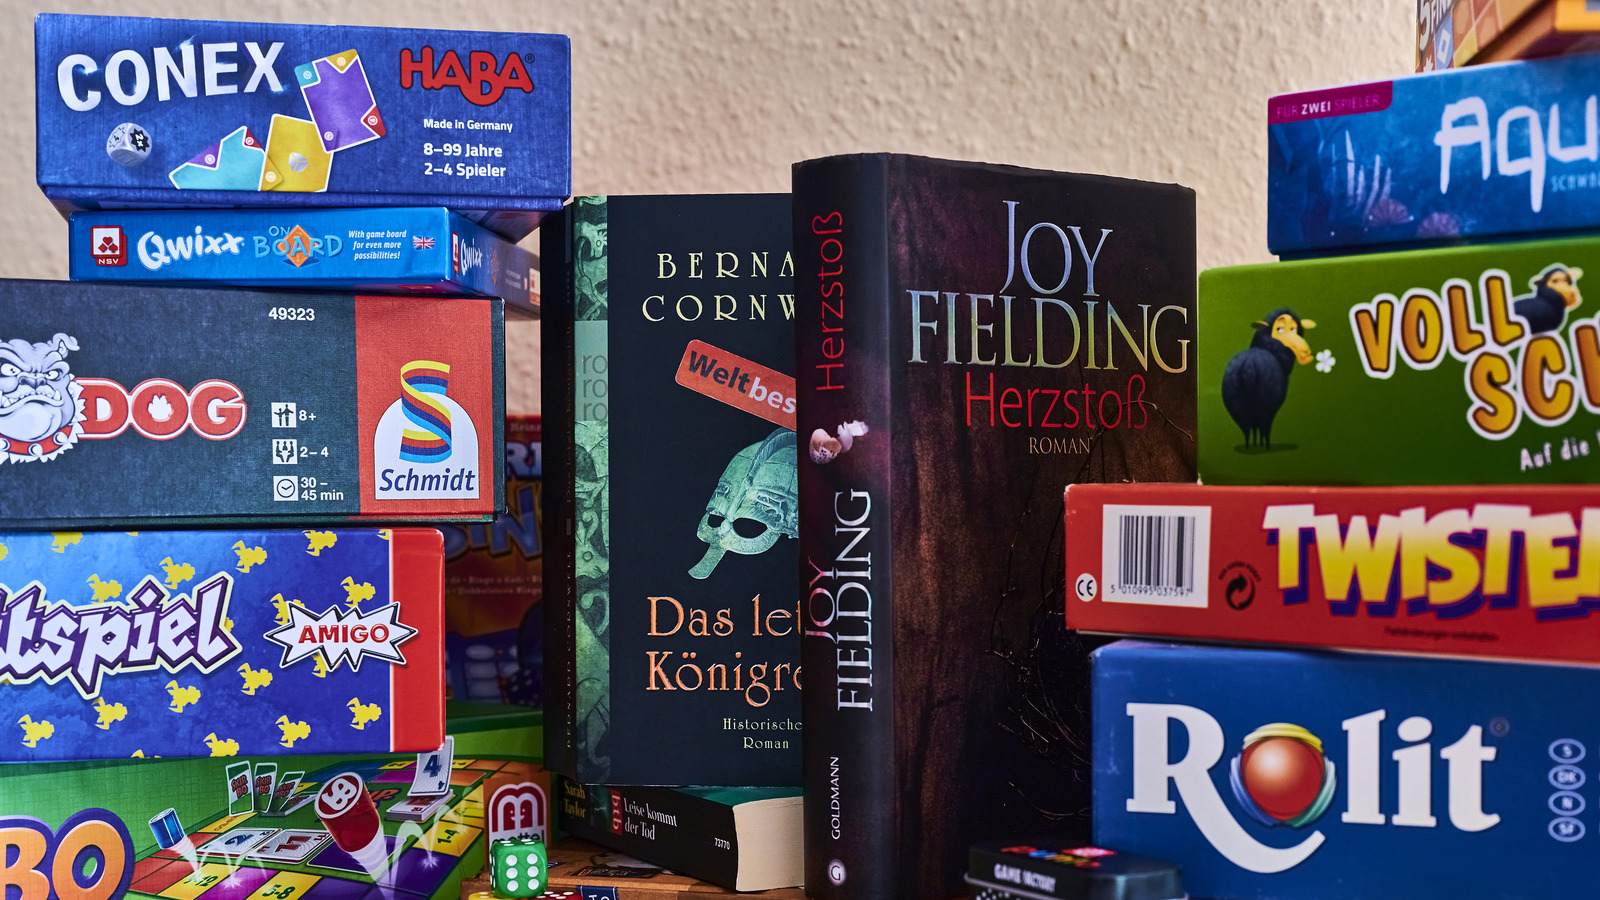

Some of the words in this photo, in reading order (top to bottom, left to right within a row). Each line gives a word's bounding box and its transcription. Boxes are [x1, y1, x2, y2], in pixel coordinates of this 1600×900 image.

[57, 41, 285, 112] CONEX
[400, 46, 535, 107] HABA
[1276, 103, 1299, 119] FÜR
[1301, 100, 1331, 115] ZWEI
[1333, 94, 1380, 112] SPIELER
[423, 118, 453, 129] Made
[455, 119, 465, 129] in
[467, 120, 513, 133] Germany
[465, 143, 503, 157] Jahre
[1434, 95, 1598, 213] Aqu
[456, 163, 506, 179] Spieler
[268, 225, 291, 237] ON
[349, 230, 365, 238] With
[366, 231, 385, 240] game
[387, 230, 407, 238] board
[137, 225, 245, 271] Qwixx
[253, 235, 343, 258] BOARD
[353, 241, 364, 250] for
[354, 251, 400, 261] possibilities!
[460, 237, 483, 276] Qwixx
[999, 200, 1113, 297] JOY
[812, 211, 845, 391] Herzstoß
[268, 307, 316, 321] 49323
[1350, 269, 1526, 379] VOLL
[906, 289, 1191, 374] FIELDING
[688, 350, 797, 414] Weltbes
[74, 378, 248, 441] DOG
[966, 371, 1148, 429] Herzstoß
[298, 409, 317, 421] 8+
[1029, 436, 1091, 454] ROMAN
[1520, 442, 1552, 473] Auf
[1560, 436, 1589, 461] die
[301, 477, 317, 488] 30
[379, 468, 476, 492] Schmidt
[301, 489, 317, 500] 45
[320, 489, 344, 501] min
[804, 555, 838, 644] JOY
[834, 488, 873, 712] FIELDING
[647, 596, 734, 637] Das
[0, 574, 239, 696] tspiel
[298, 624, 390, 645] AMIGO
[723, 718, 802, 731] Historische
[743, 736, 790, 749] Roman
[423, 754, 442, 777] 4
[236, 784, 248, 798] BO
[259, 785, 271, 794] BO
[564, 780, 586, 800] Sarah
[830, 756, 841, 840] GOLDMANN
[1125, 702, 1501, 874] Rolit
[563, 798, 586, 819] Taylor
[612, 794, 622, 830] btb
[623, 797, 645, 817] Leise
[646, 803, 678, 827] kommt
[438, 829, 459, 844] 1-4
[624, 817, 639, 835] der
[640, 822, 656, 841] Tod
[0, 808, 135, 900] BO
[714, 837, 731, 850] 73770
[994, 863, 1021, 884] GAME
[262, 884, 296, 899] 5-8
